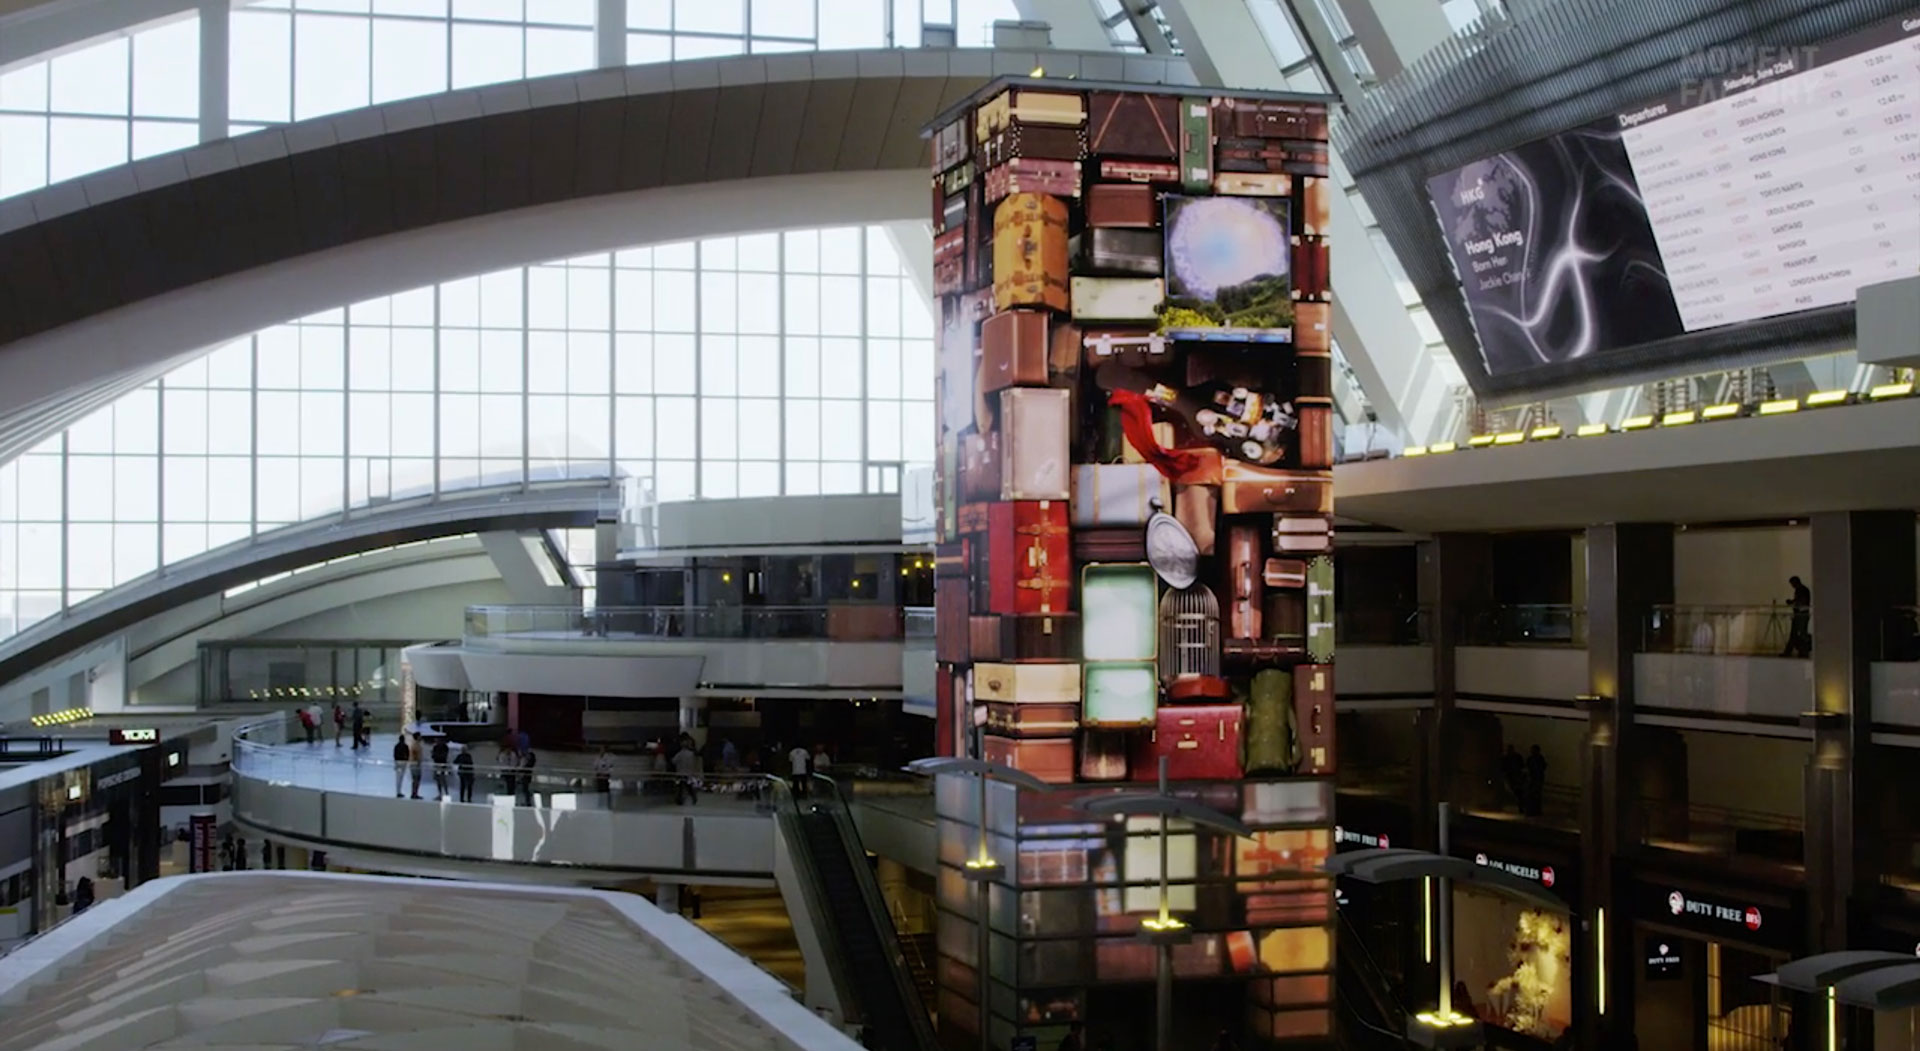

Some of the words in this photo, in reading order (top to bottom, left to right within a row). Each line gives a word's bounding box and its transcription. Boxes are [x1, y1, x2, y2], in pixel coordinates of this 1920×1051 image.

[1756, 66, 1774, 80] June
[1618, 104, 1668, 127] Departures
[1460, 186, 1485, 205] HKG
[1464, 238, 1495, 255] Hong
[1492, 230, 1524, 248] Kong
[1344, 831, 1361, 843] DUTY
[1362, 834, 1378, 846] FREE
[1505, 863, 1540, 880] ANGELES
[1686, 900, 1713, 916] DUTY
[1716, 906, 1742, 922] FREE
[1648, 956, 1664, 965] DUTY
